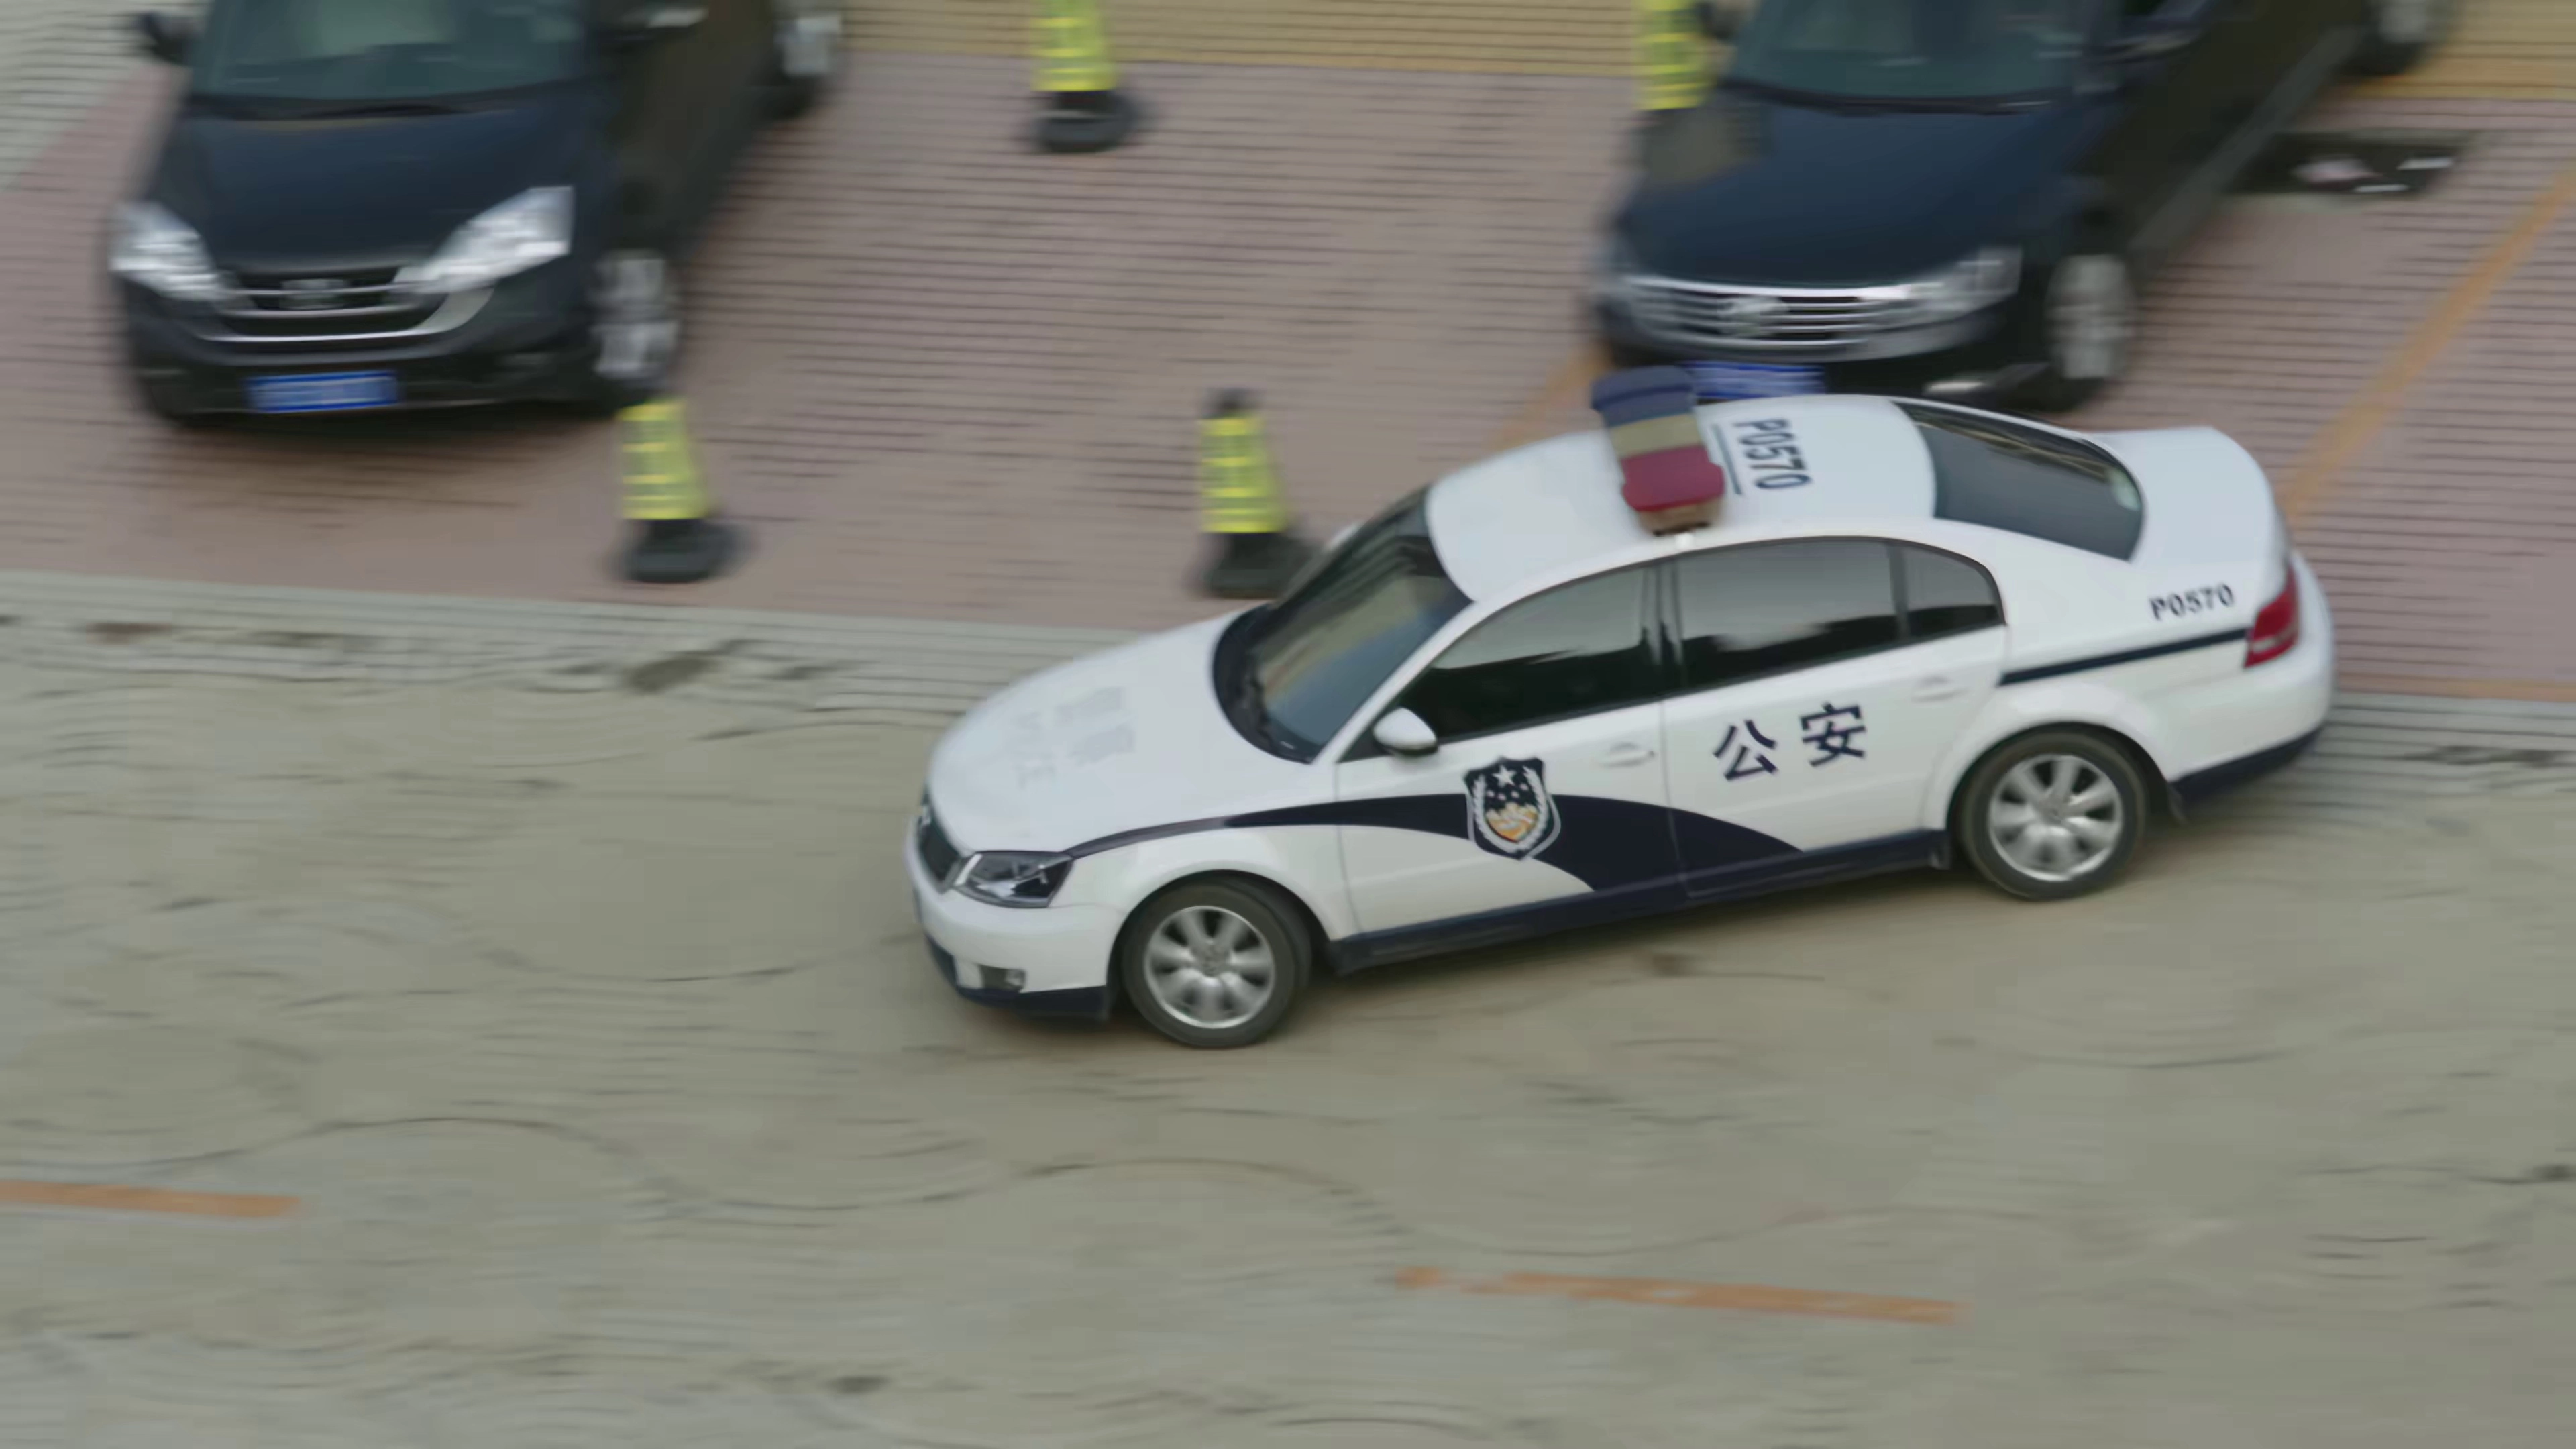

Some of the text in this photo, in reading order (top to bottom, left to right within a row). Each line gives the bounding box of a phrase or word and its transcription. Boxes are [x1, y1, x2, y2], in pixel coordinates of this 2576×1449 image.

[1732, 419, 1812, 489] P0570
[2149, 583, 2234, 621] P0570
[1713, 702, 1866, 780] 公安
